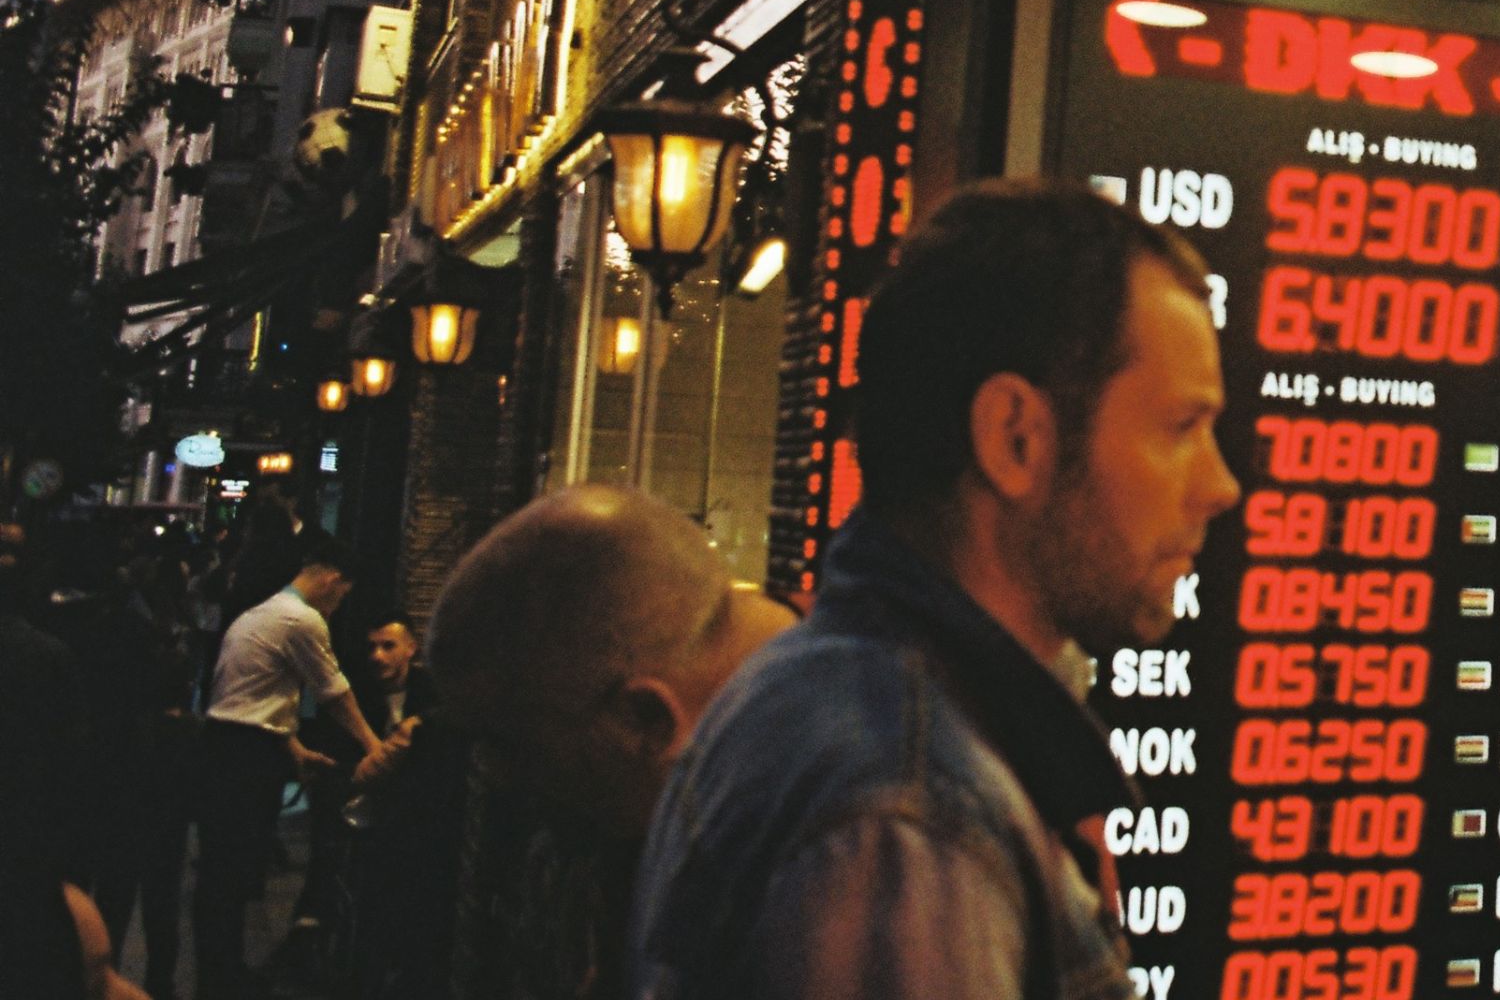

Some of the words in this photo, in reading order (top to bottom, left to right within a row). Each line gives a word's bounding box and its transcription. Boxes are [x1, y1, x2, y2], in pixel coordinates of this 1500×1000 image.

[1307, 127, 1364, 163] ALIŞ
[1383, 135, 1477, 170] BUYING
[1139, 166, 1234, 229] USD
[1261, 371, 1320, 407] ALIŞ
[1340, 376, 1436, 407] BUYING
[1111, 648, 1191, 697] SEK
[1110, 727, 1197, 776] NOK
[1104, 806, 1190, 856] CAD
[1115, 886, 1186, 935] UD
